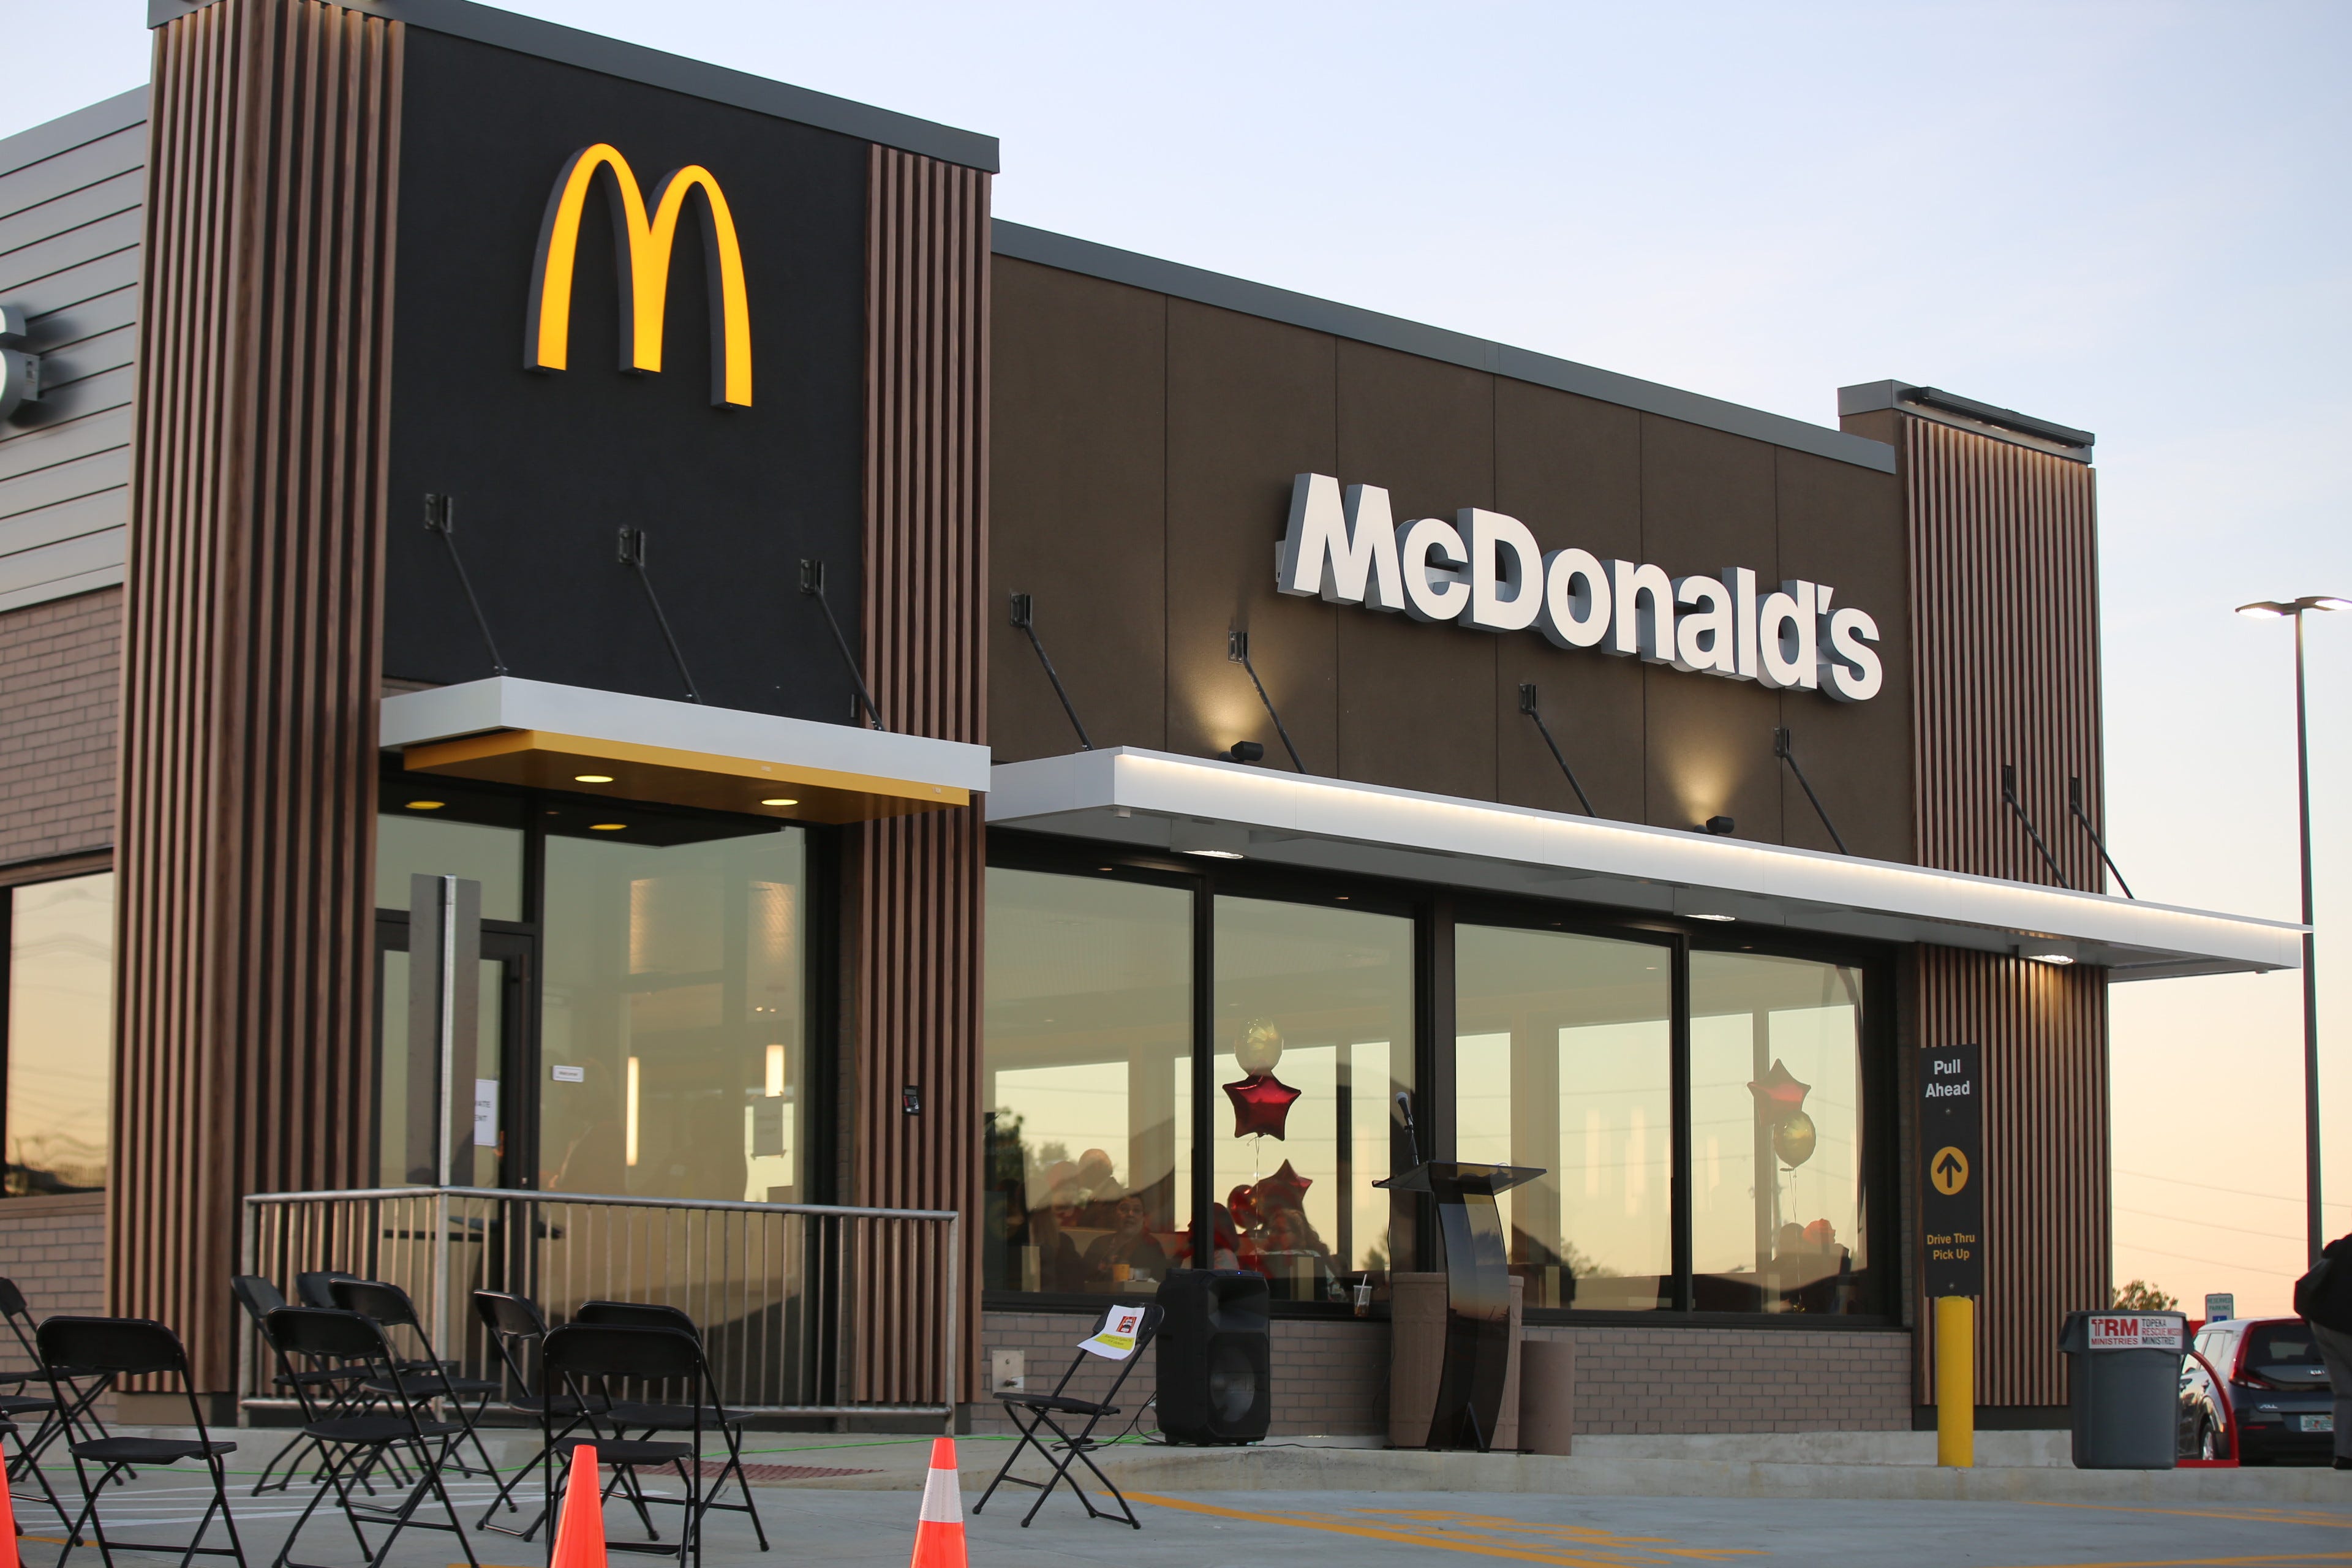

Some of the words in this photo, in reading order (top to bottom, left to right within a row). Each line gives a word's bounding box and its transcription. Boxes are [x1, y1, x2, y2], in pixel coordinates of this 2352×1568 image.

[1278, 472, 1882, 703] McDonald's
[1934, 1058, 1961, 1075] Pull
[1925, 1080, 1970, 1098] Ahead
[1927, 1234, 1951, 1245] Drive
[1954, 1232, 1975, 1243] Thru
[1933, 1250, 1954, 1260] Pick
[1956, 1248, 1970, 1261] Up
[2091, 1319, 2138, 1336] TRM
[2141, 1319, 2166, 1327] TOPEKA
[2141, 1327, 2166, 1336] RESCUE
